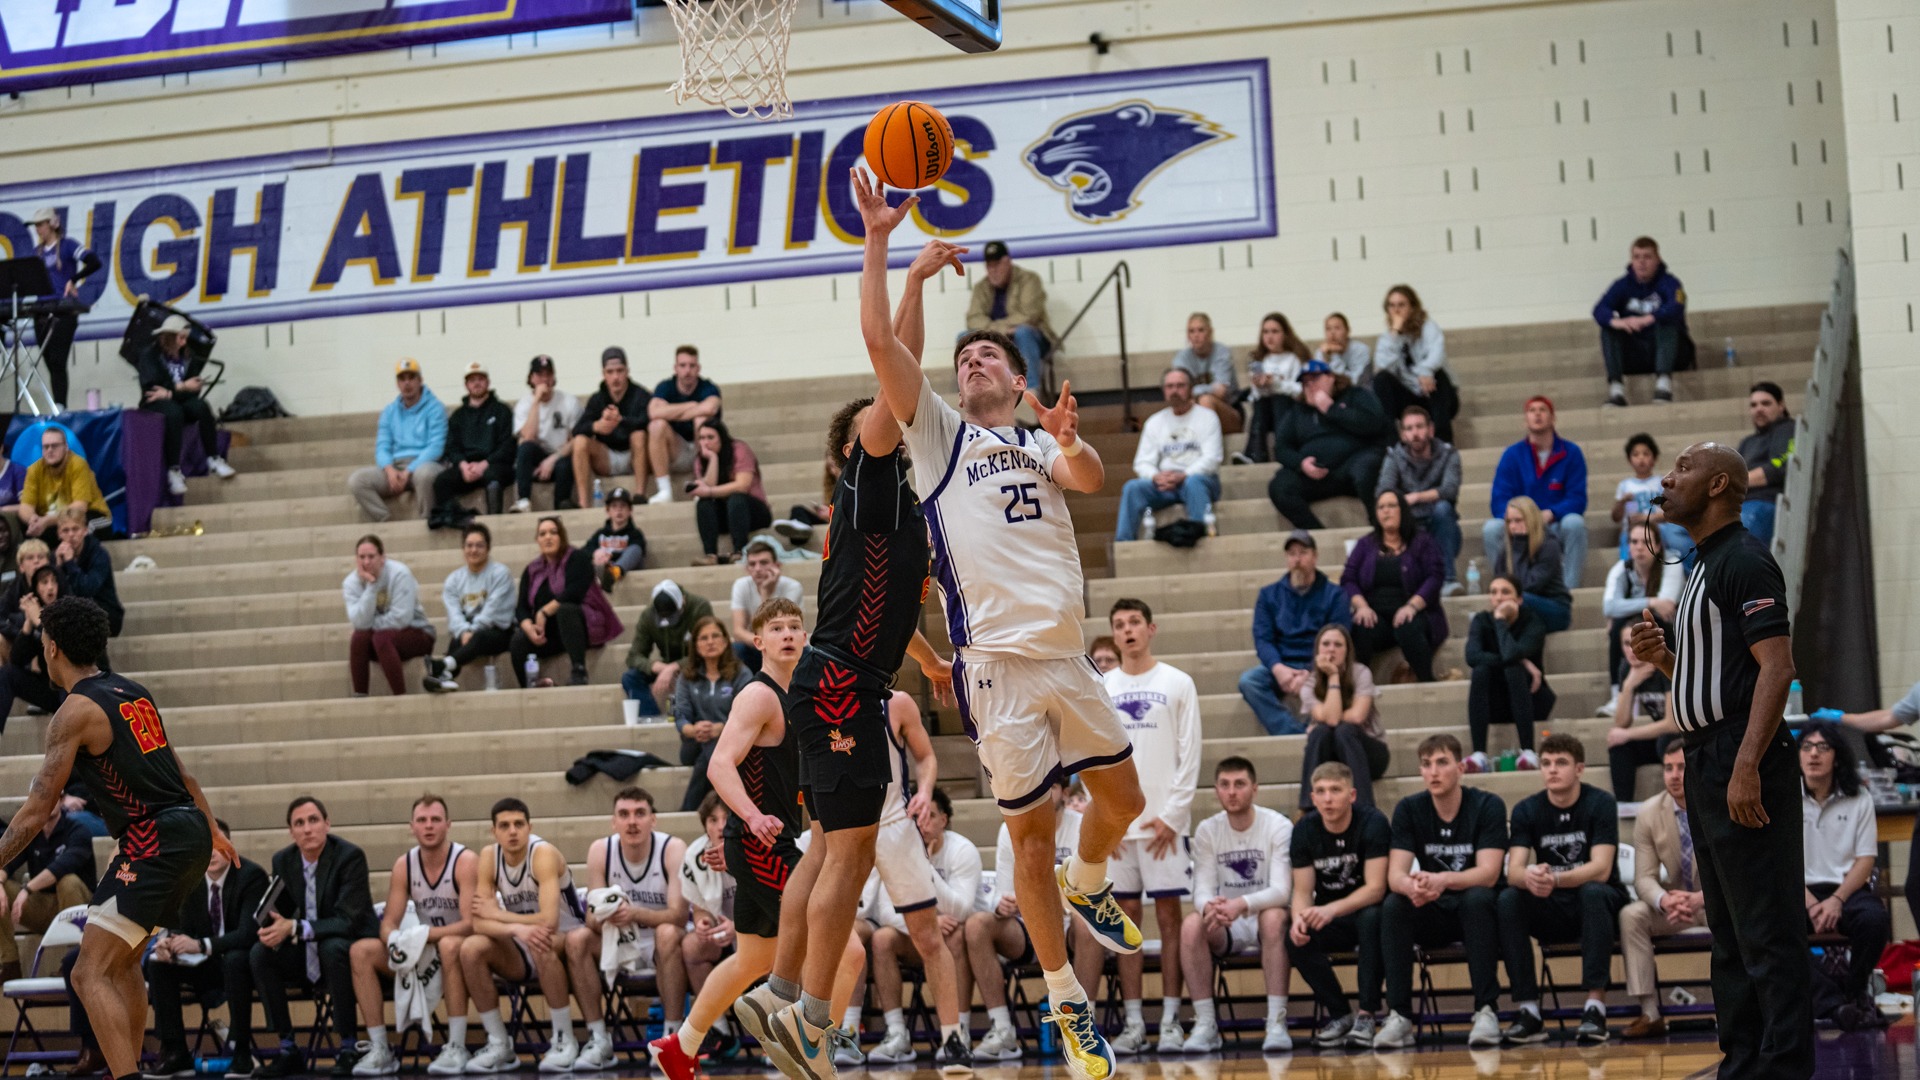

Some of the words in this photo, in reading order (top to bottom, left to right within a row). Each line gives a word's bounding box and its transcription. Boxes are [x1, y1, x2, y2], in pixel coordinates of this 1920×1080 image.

[922, 120, 940, 180] Wilson
[0, 182, 286, 308] UGH
[308, 115, 997, 292] ATHLETICS
[1000, 482, 1042, 523] 25
[119, 697, 167, 754] 20
